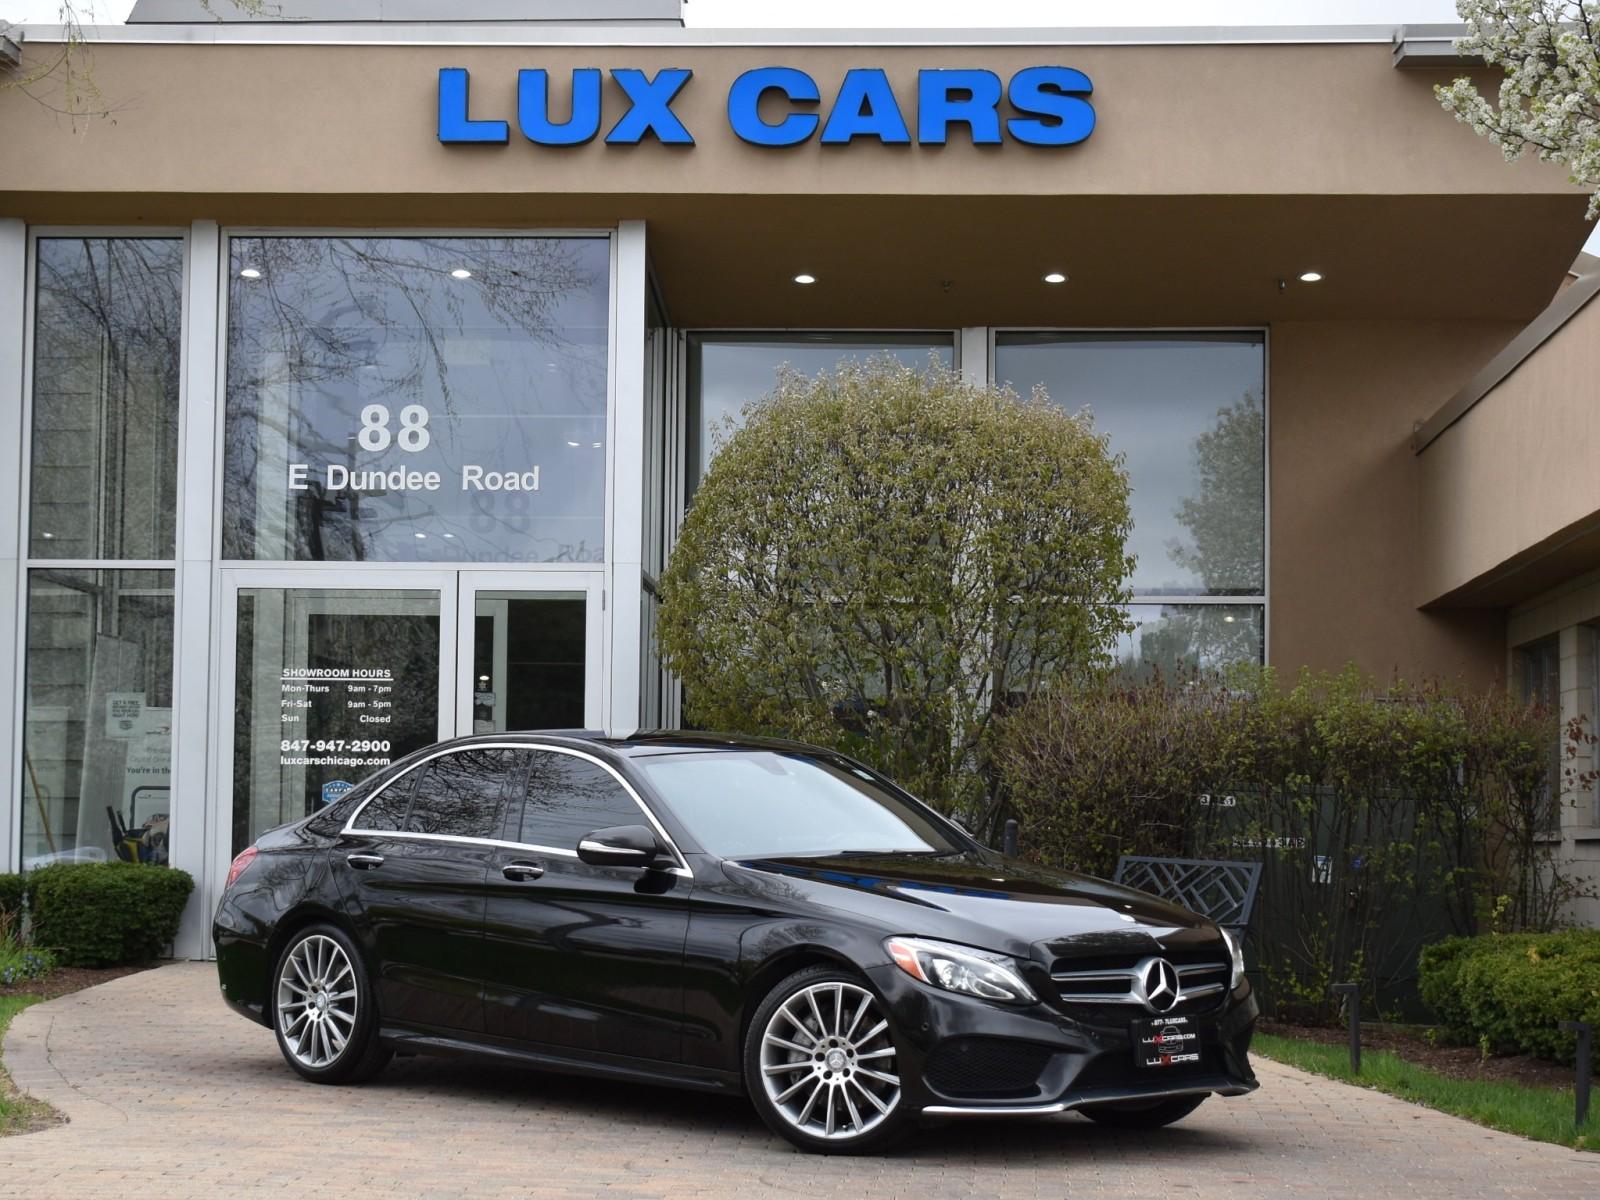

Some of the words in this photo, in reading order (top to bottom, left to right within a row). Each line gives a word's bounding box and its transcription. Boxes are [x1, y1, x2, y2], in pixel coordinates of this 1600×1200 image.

[437, 67, 696, 147] LUX
[727, 65, 1097, 147] CARS
[358, 404, 431, 452] 88
[288, 464, 308, 490] E
[326, 464, 441, 491] Dundee
[462, 465, 540, 491] Road
[283, 668, 350, 678] SHOWROOM
[352, 669, 391, 678] HOURS
[281, 684, 330, 693] Mon-Thurs
[347, 685, 366, 693] 9am
[373, 685, 392, 695] 7pm
[281, 700, 313, 708] Fri-Sat
[347, 701, 366, 709] 9am
[373, 701, 392, 710] 5pm
[281, 714, 300, 722] Sun
[360, 714, 391, 723] Closed
[280, 740, 391, 752] 847-947-2900
[280, 755, 391, 767] luxcarschicago.com
[161, 766, 171, 774] th
